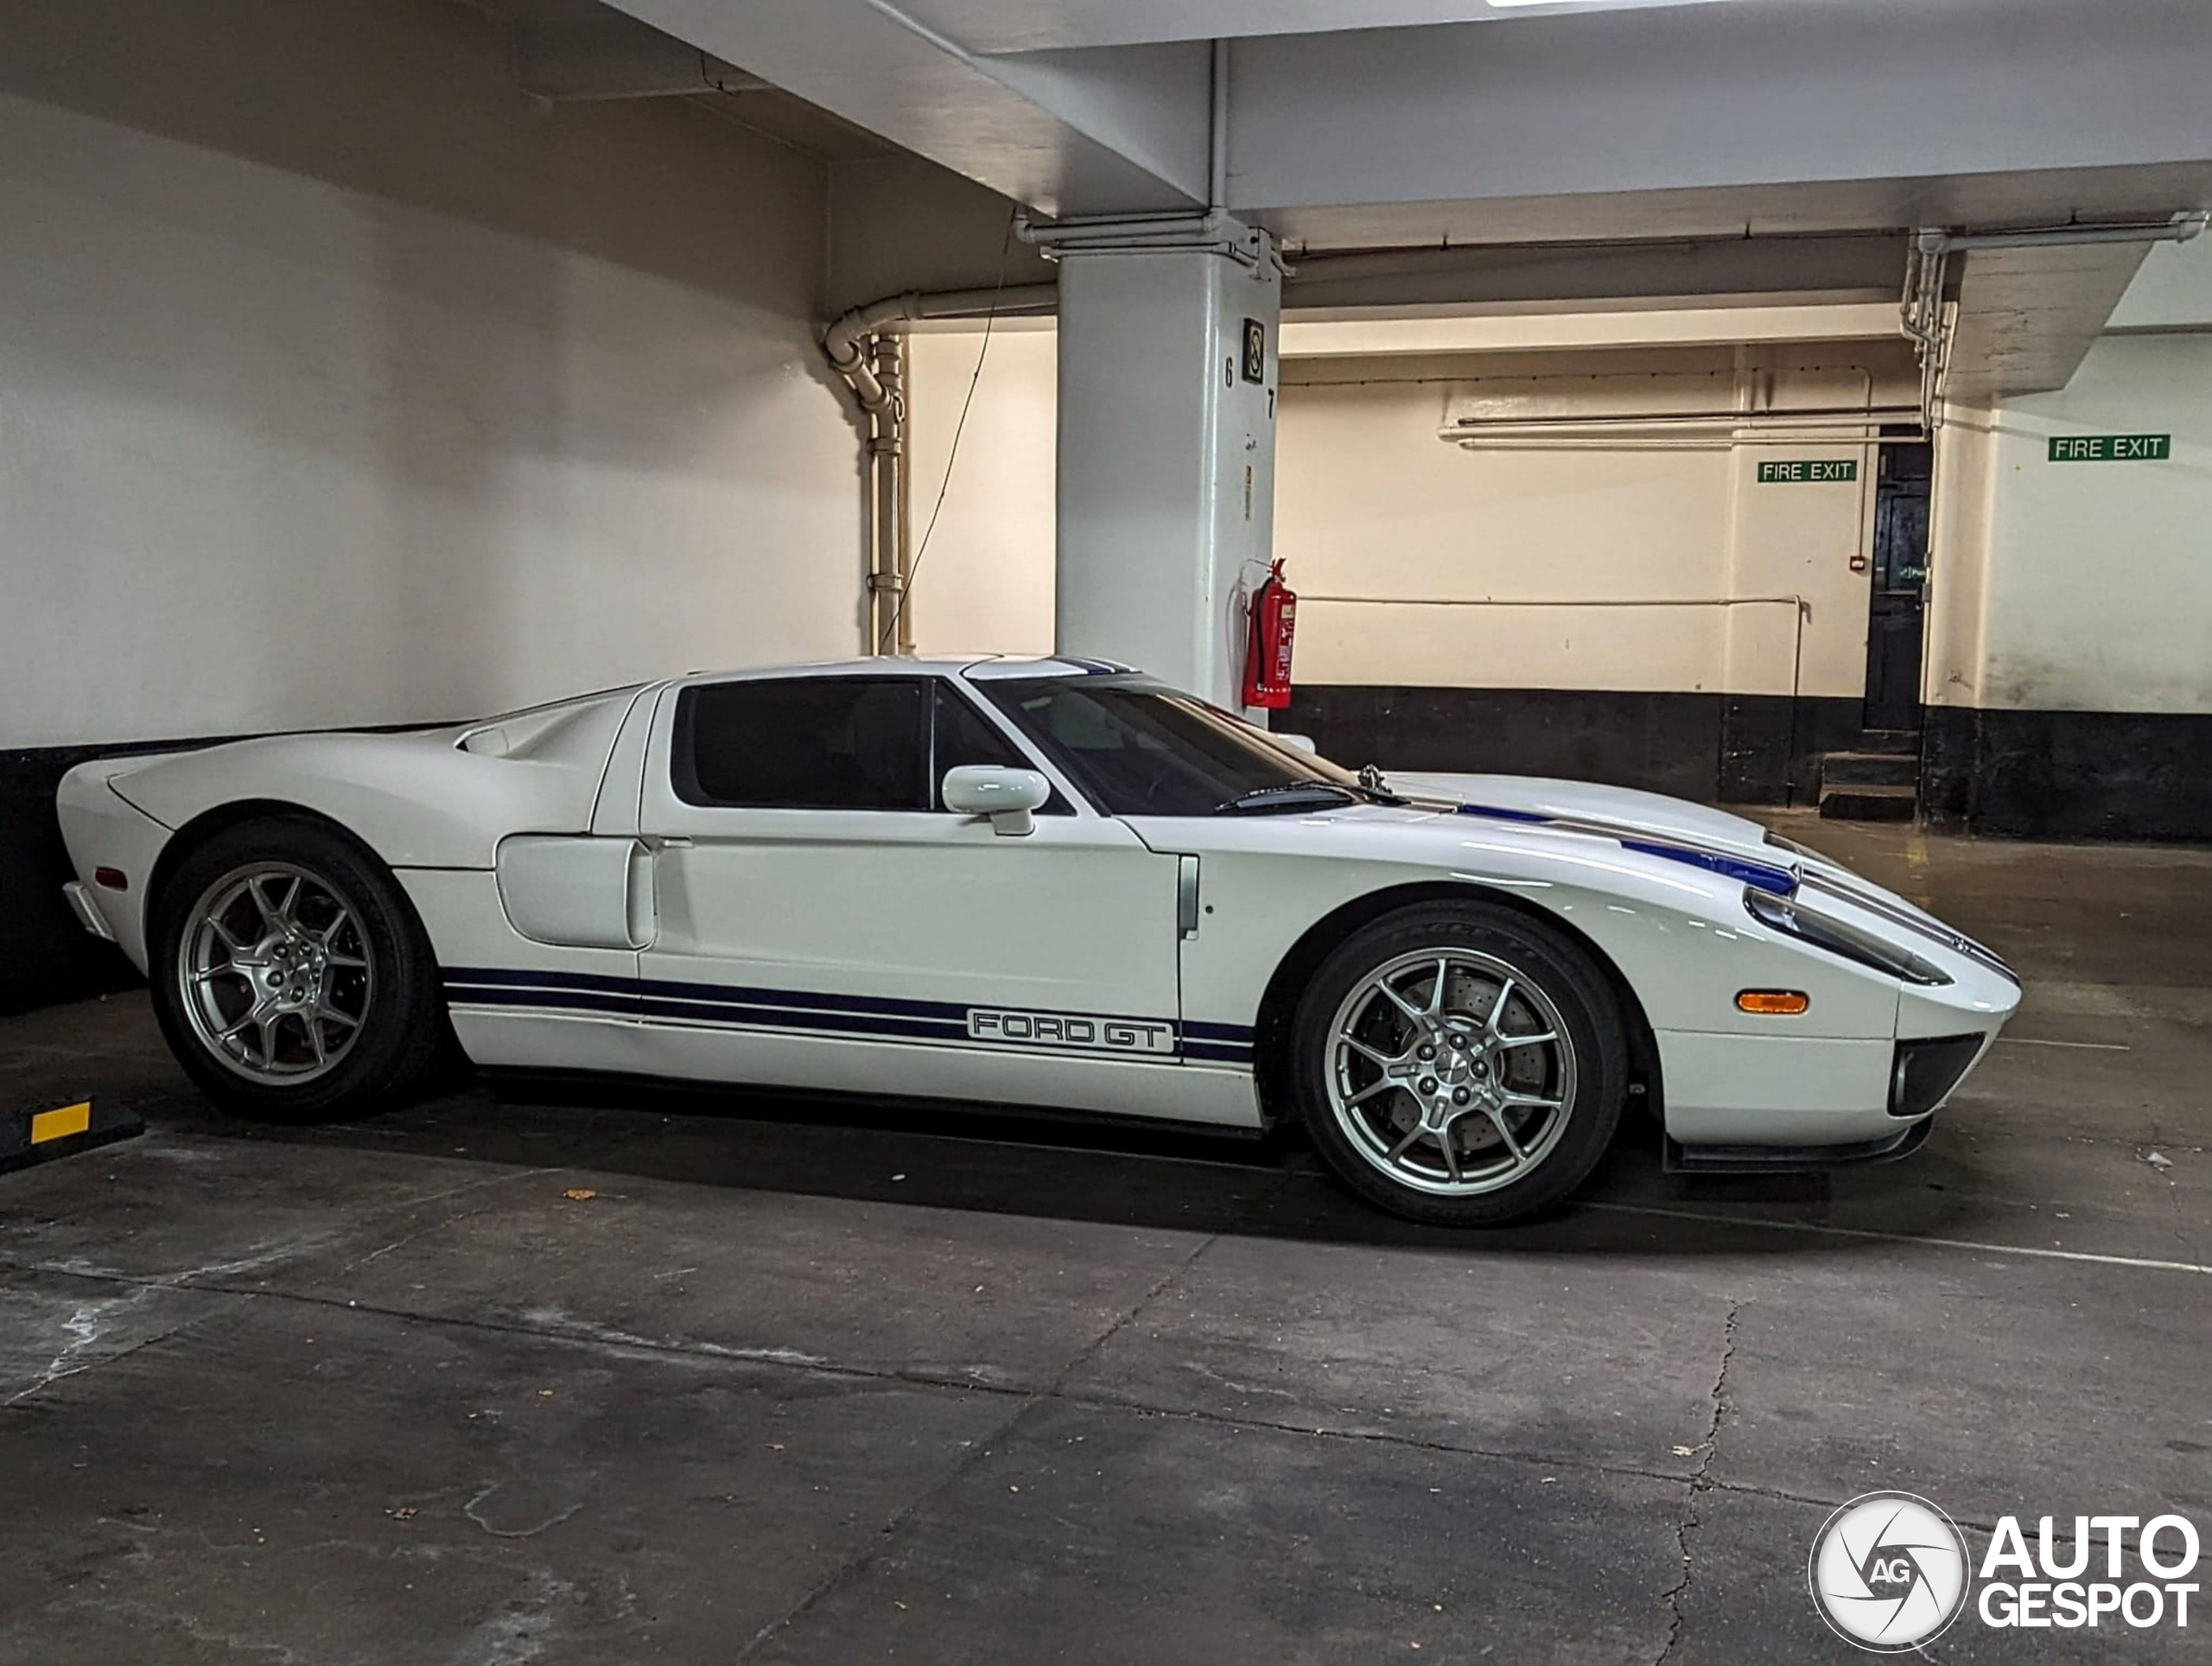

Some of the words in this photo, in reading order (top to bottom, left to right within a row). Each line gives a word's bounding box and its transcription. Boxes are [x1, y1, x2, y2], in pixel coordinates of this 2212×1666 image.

[1225, 356, 1232, 388] 6
[1268, 388, 1274, 419] 7
[2056, 439, 2103, 458] FIRE
[2113, 438, 2164, 457] EXIT
[1764, 464, 1802, 480] FIRE
[1810, 462, 1852, 480] EXIT
[973, 1013, 1095, 1043] FORD
[1104, 1022, 1166, 1048] GT
